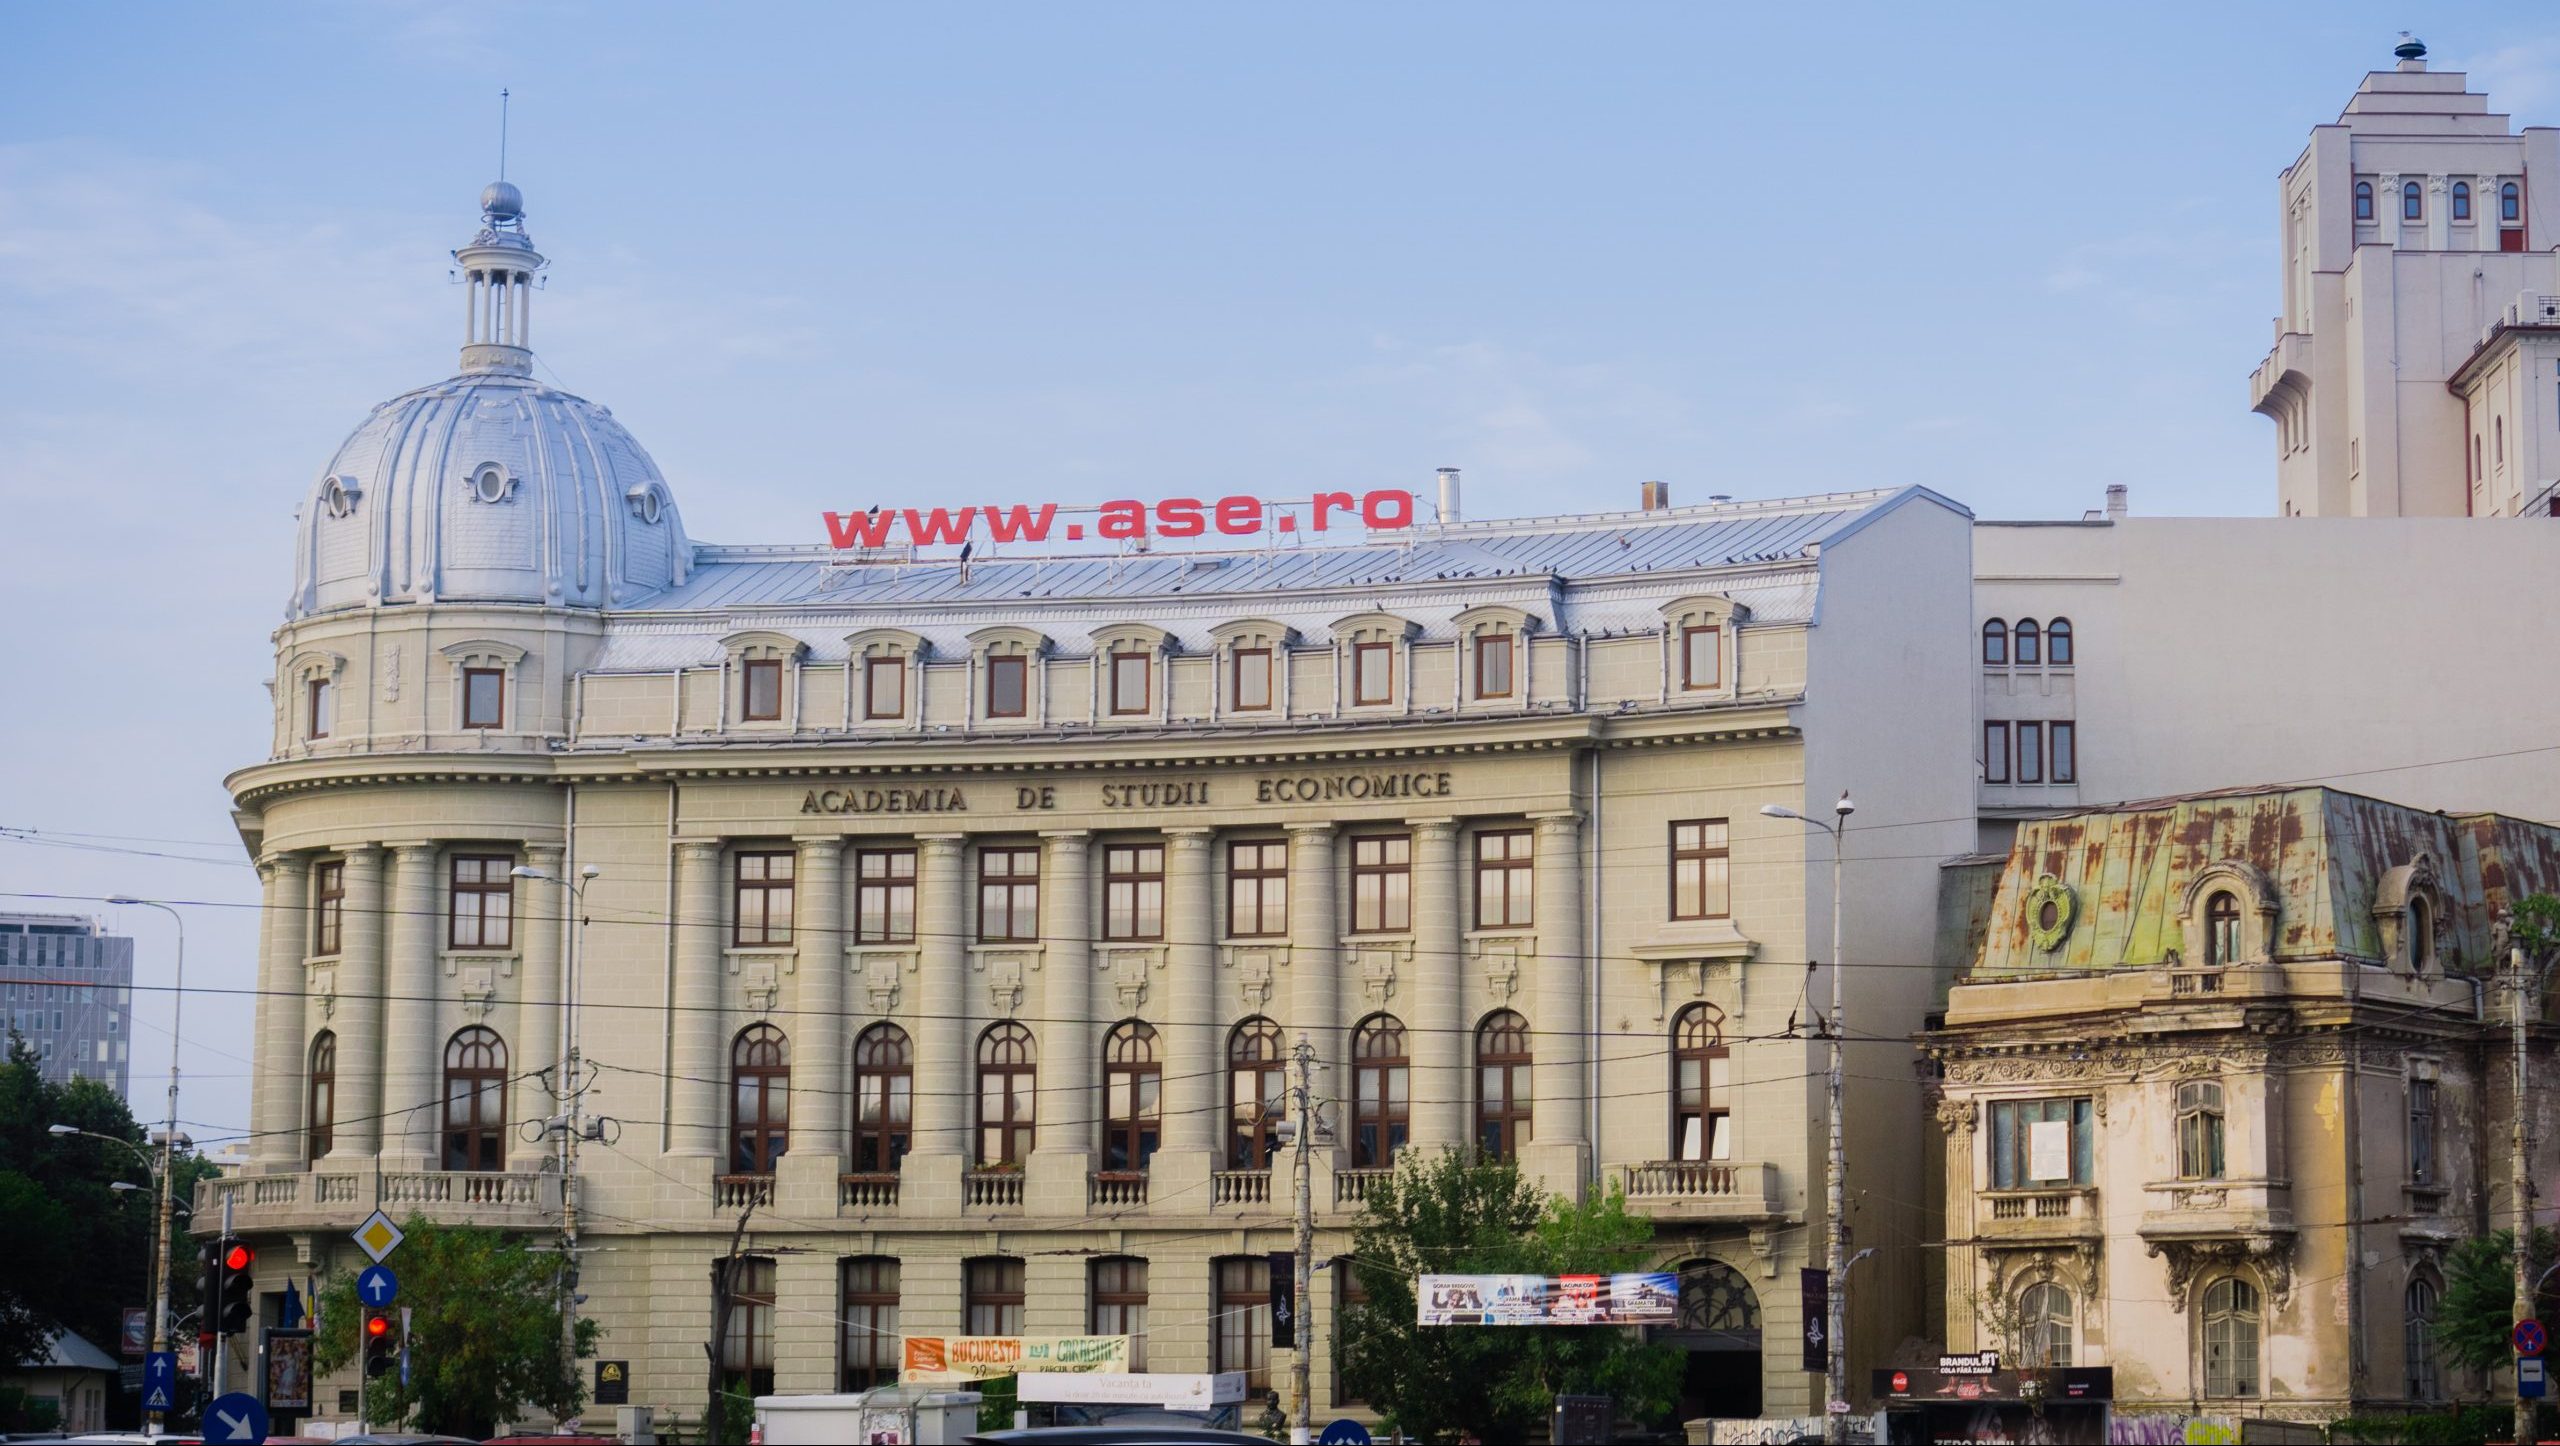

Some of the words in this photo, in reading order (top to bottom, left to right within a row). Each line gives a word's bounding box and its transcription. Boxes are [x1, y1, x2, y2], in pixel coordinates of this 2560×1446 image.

[822, 489, 1413, 549] www.ase.ro
[801, 787, 967, 813] ACADEMIA
[1016, 786, 1055, 809] DE
[1101, 781, 1209, 807] STUDII
[1255, 772, 1452, 802] ECONOMICE
[1940, 1357, 1981, 1367] BRANDUL
